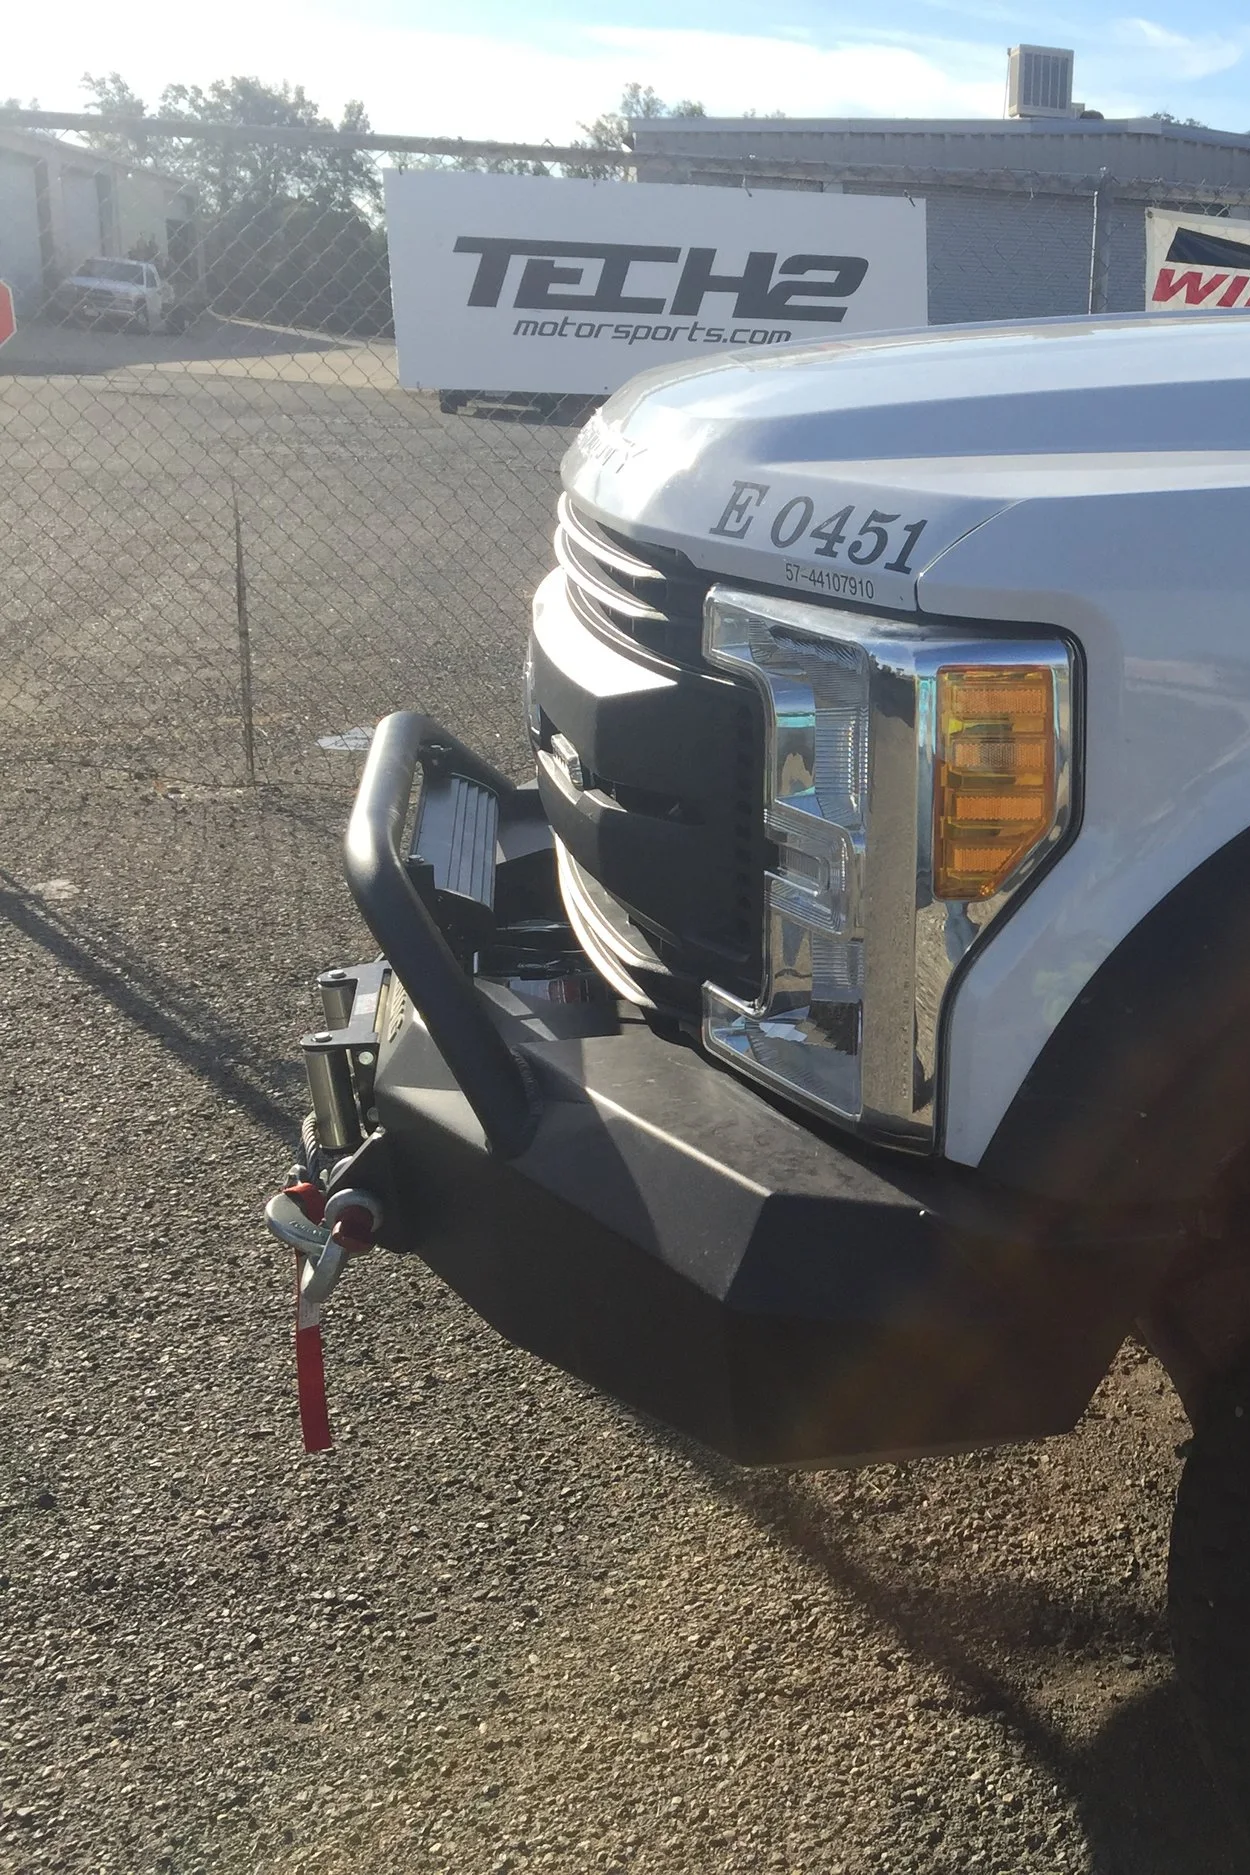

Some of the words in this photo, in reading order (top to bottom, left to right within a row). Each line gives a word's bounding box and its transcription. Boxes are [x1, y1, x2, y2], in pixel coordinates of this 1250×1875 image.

[453, 236, 869, 322] TECH2
[513, 316, 792, 345] motorsports.com
[709, 480, 771, 539] E
[770, 496, 928, 574] 0451
[785, 562, 875, 599] 57-44107910
